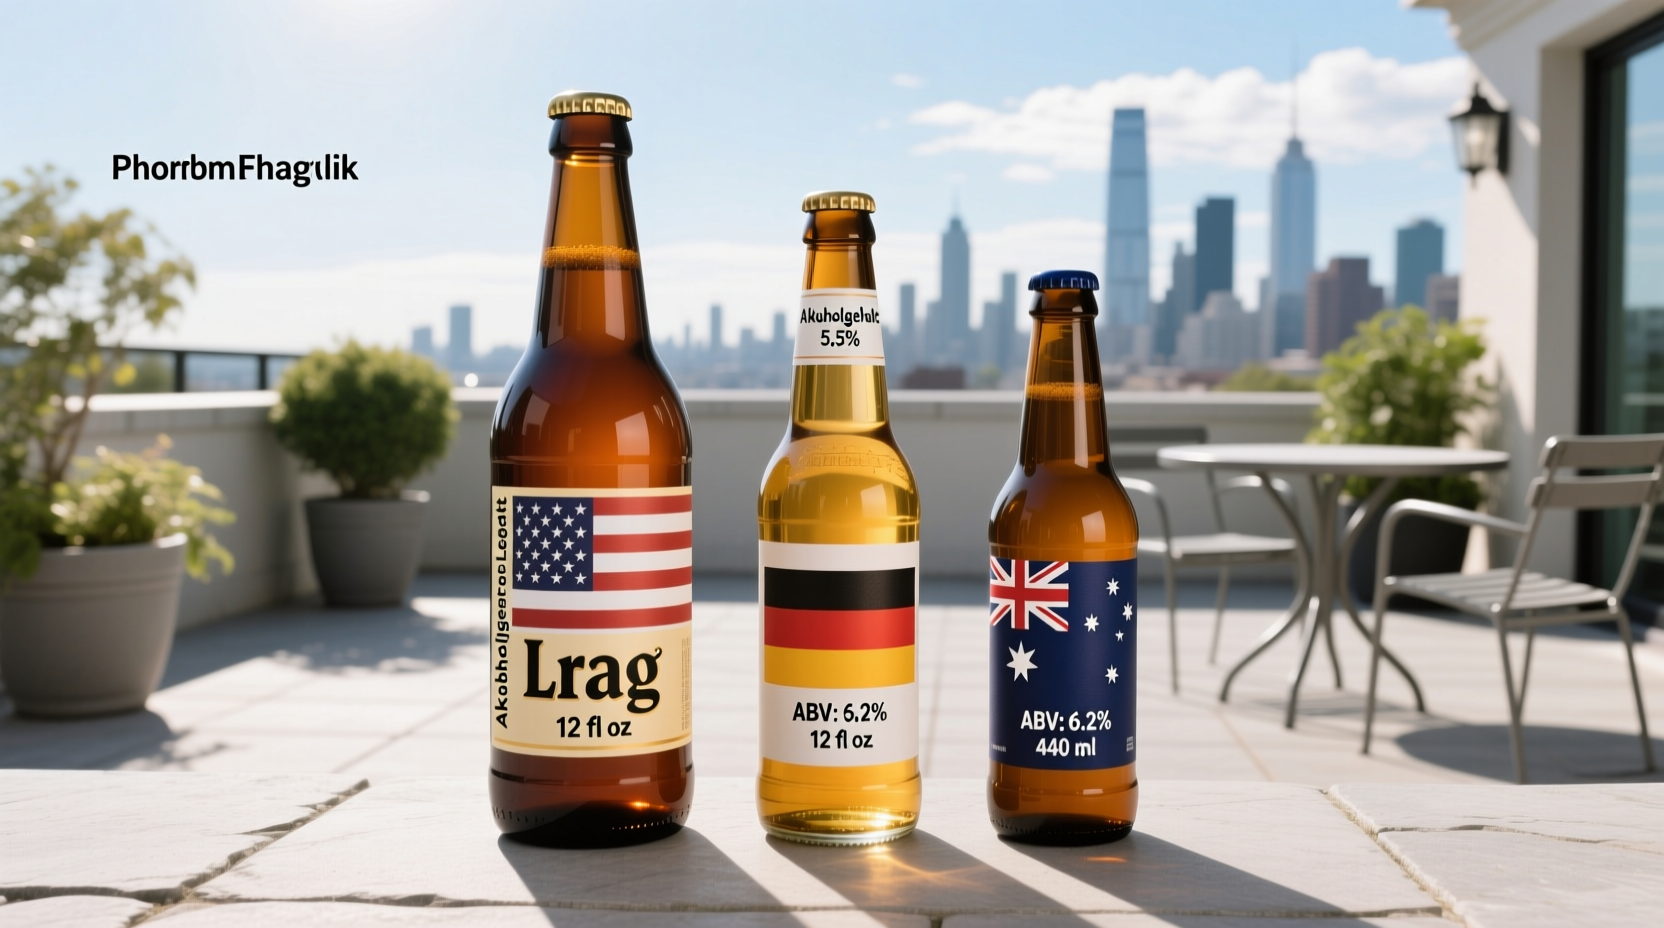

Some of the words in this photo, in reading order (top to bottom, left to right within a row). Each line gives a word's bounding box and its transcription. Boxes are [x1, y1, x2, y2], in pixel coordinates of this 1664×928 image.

[820, 329, 860, 348] 5.5%
[523, 638, 663, 714] Lrag
[792, 701, 838, 723] ABV:
[843, 702, 888, 723] 6.2%
[1020, 710, 1065, 732] ABV:
[1068, 709, 1112, 732] 6.2%
[556, 716, 581, 738] 12
[586, 714, 602, 738] fl
[607, 720, 632, 737] oz
[810, 729, 831, 749] 12
[834, 728, 848, 749] fl
[852, 734, 874, 749] oz
[1035, 737, 1070, 757] 440
[1074, 736, 1096, 757] ml
